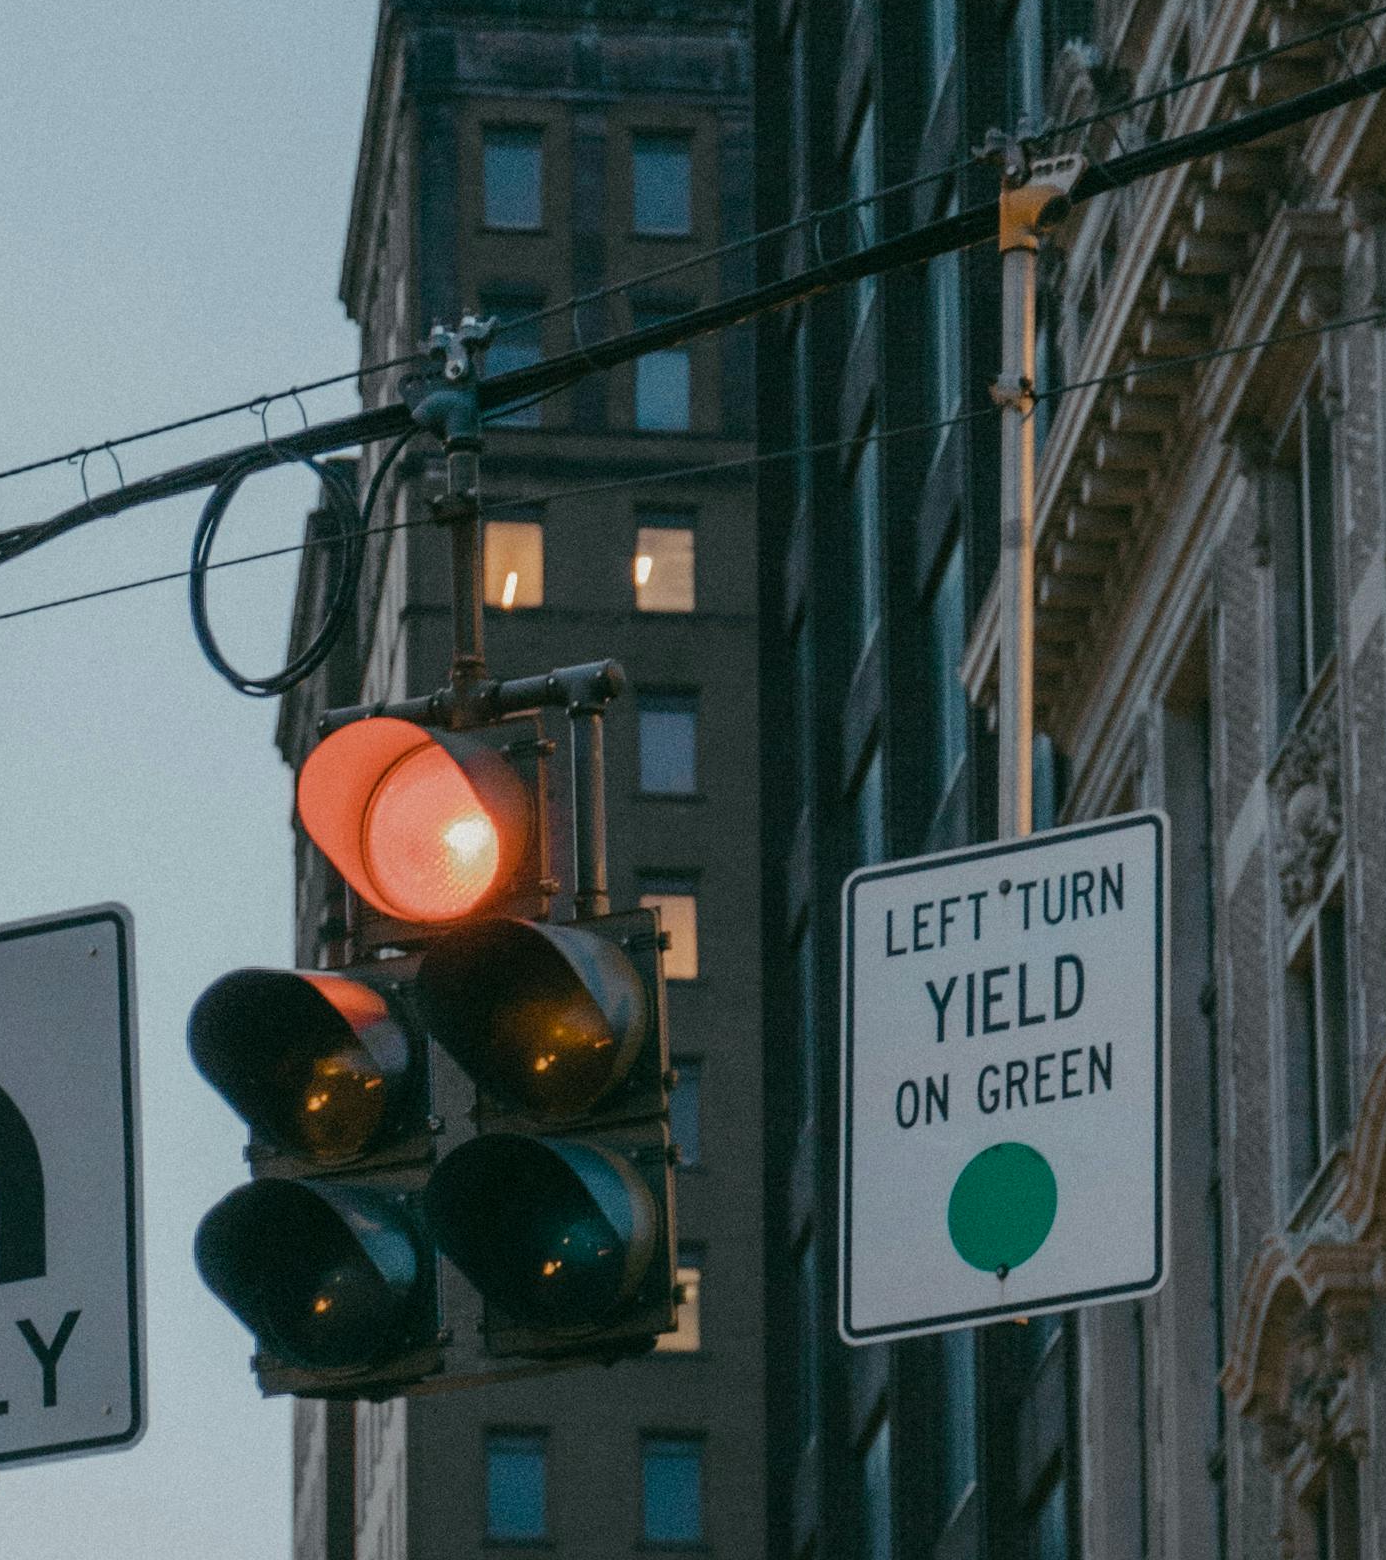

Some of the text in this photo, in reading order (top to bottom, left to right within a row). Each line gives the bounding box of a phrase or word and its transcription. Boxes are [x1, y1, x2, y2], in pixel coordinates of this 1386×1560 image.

[885, 863, 1125, 957] LEFT TURN
[925, 954, 1086, 1043] YIELD
[896, 1042, 1113, 1130] ON GREEN
